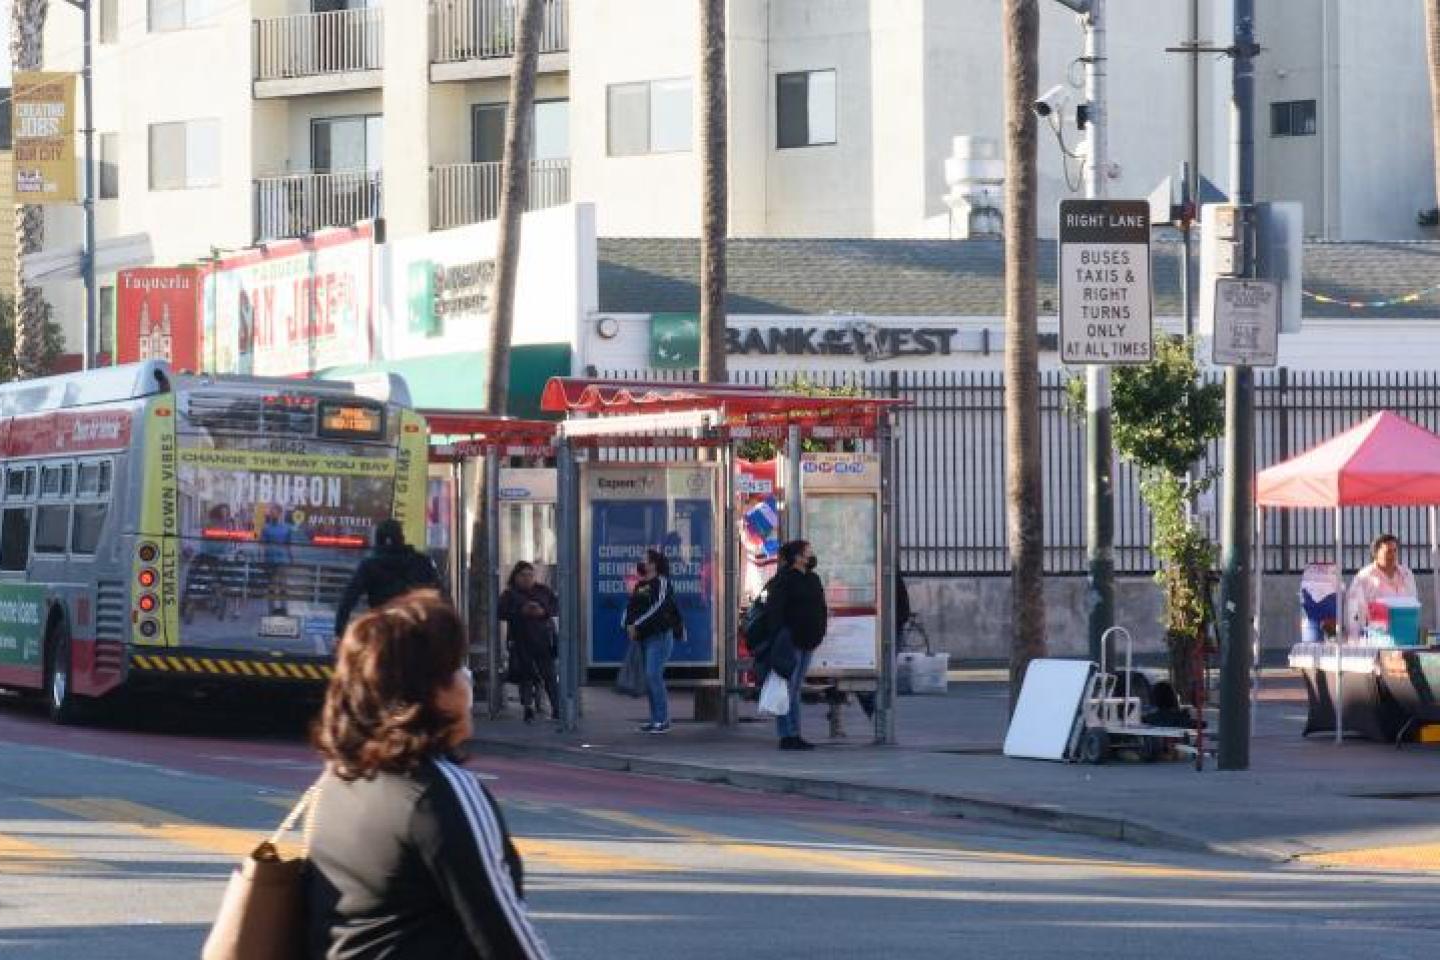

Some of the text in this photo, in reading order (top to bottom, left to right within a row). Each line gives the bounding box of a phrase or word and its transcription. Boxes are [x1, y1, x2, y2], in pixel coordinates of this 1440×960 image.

[16, 118, 59, 136] JOBS
[1066, 215, 1144, 227] RIGHT LANE
[1081, 250, 1130, 265] BUSES
[123, 272, 189, 291] Taqueria
[1076, 269, 1135, 283] TAXIS &
[1083, 287, 1128, 301] RIGHT
[287, 271, 336, 343] JOSE
[1081, 305, 1130, 319] TURNS
[1087, 323, 1126, 337] ONLY
[726, 328, 816, 355] BANK
[853, 328, 958, 356] WEST
[1066, 341, 1080, 355] AT
[1085, 341, 1106, 355] ALL
[1112, 342, 1148, 356] TIMES
[181, 453, 389, 472] CHANGE THE WAY YOU BAY
[234, 471, 342, 508] TIBURON
[162, 434, 175, 604] SMALL TOWN VIBES
[309, 515, 372, 528] MAIN STREET
